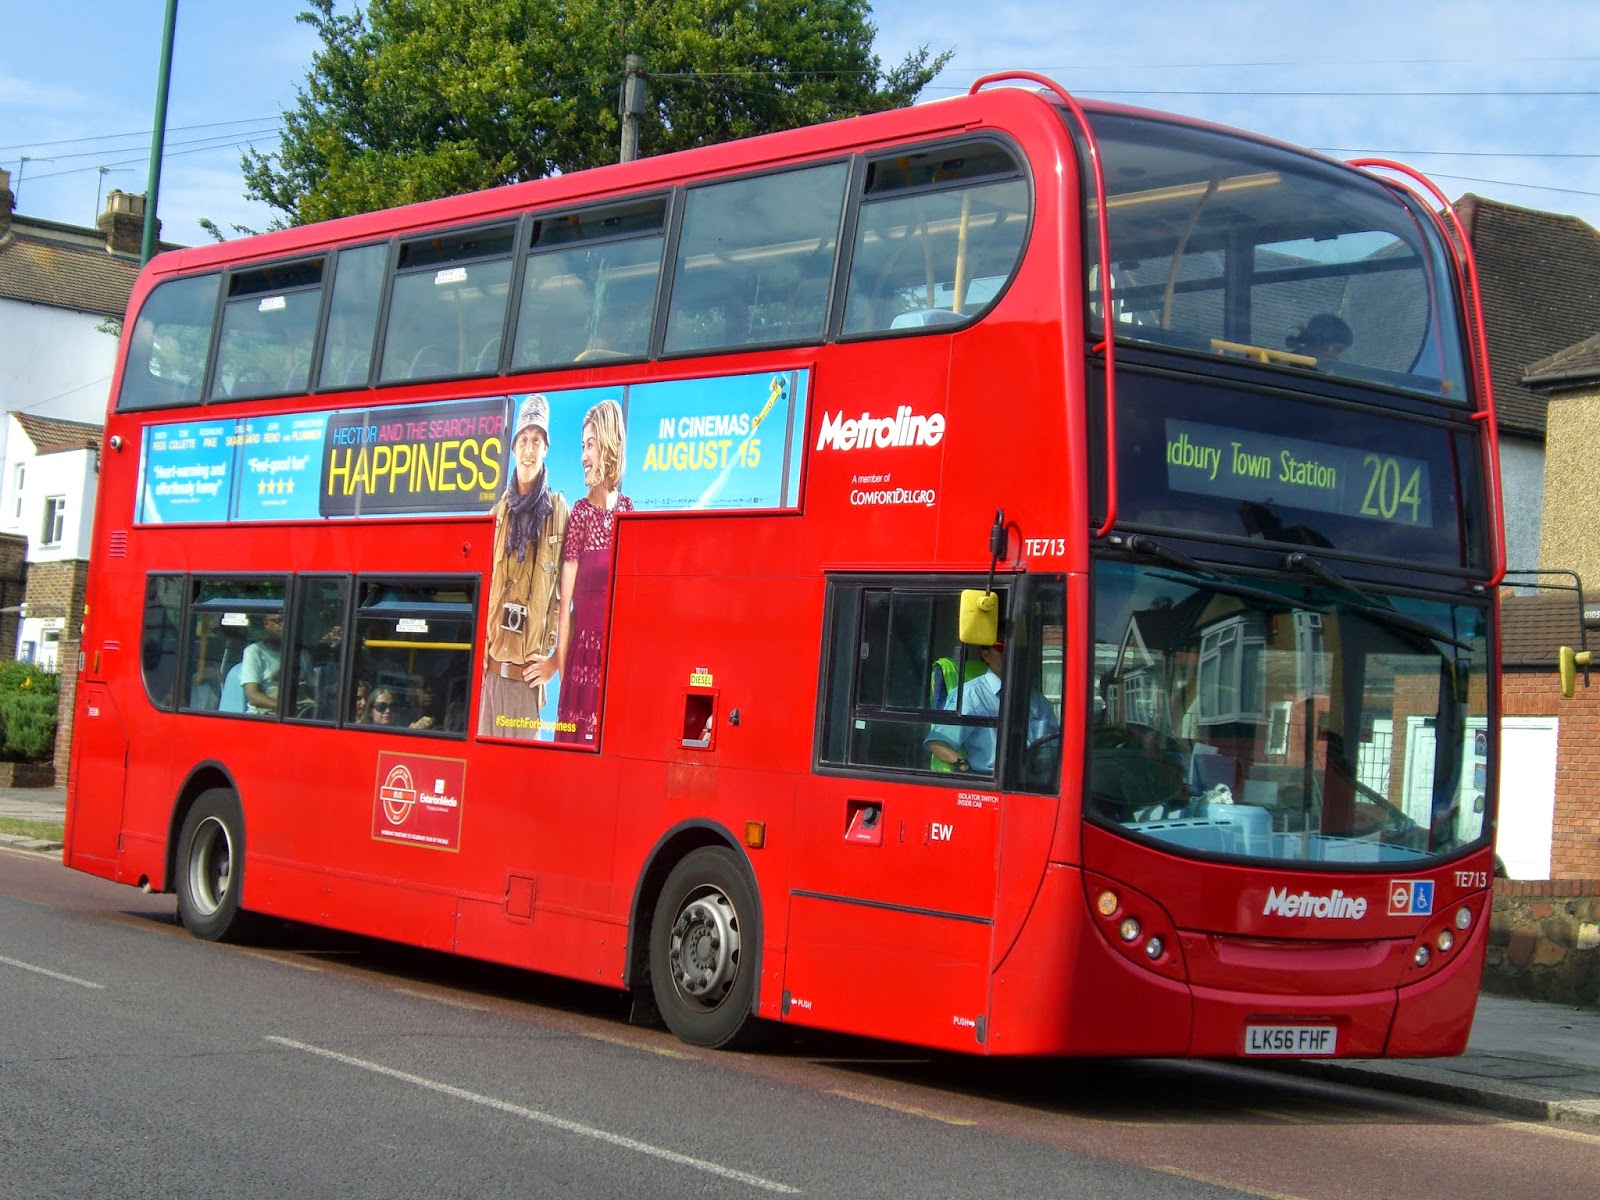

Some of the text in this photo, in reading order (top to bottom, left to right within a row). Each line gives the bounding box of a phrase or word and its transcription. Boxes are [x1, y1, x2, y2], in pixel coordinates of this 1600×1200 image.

[333, 416, 504, 445] HECTOR AND THE SEARCH FOR
[659, 413, 750, 439] IN CINEMAS
[816, 405, 946, 451] Metroline
[642, 438, 761, 471] AUGUST 15
[328, 438, 502, 496] HAPPINESS
[852, 472, 891, 484] A member of
[1231, 441, 1271, 479] Town
[1279, 449, 1336, 489] Station
[1360, 454, 1422, 522] 204
[1025, 538, 1066, 556] TE713
[691, 675, 712, 685] DIESEL
[496, 714, 576, 732] #SearchForHappiness
[958, 792, 999, 803] ISOLATOR SWITCH
[958, 799, 972, 807] INSIDE
[931, 822, 954, 841] EW
[1455, 871, 1487, 888] TE713
[1263, 886, 1368, 920] Metroline
[798, 998, 812, 1010] PUSH
[953, 1016, 969, 1026] PUSH
[1252, 1030, 1330, 1050] LK56 FHF
